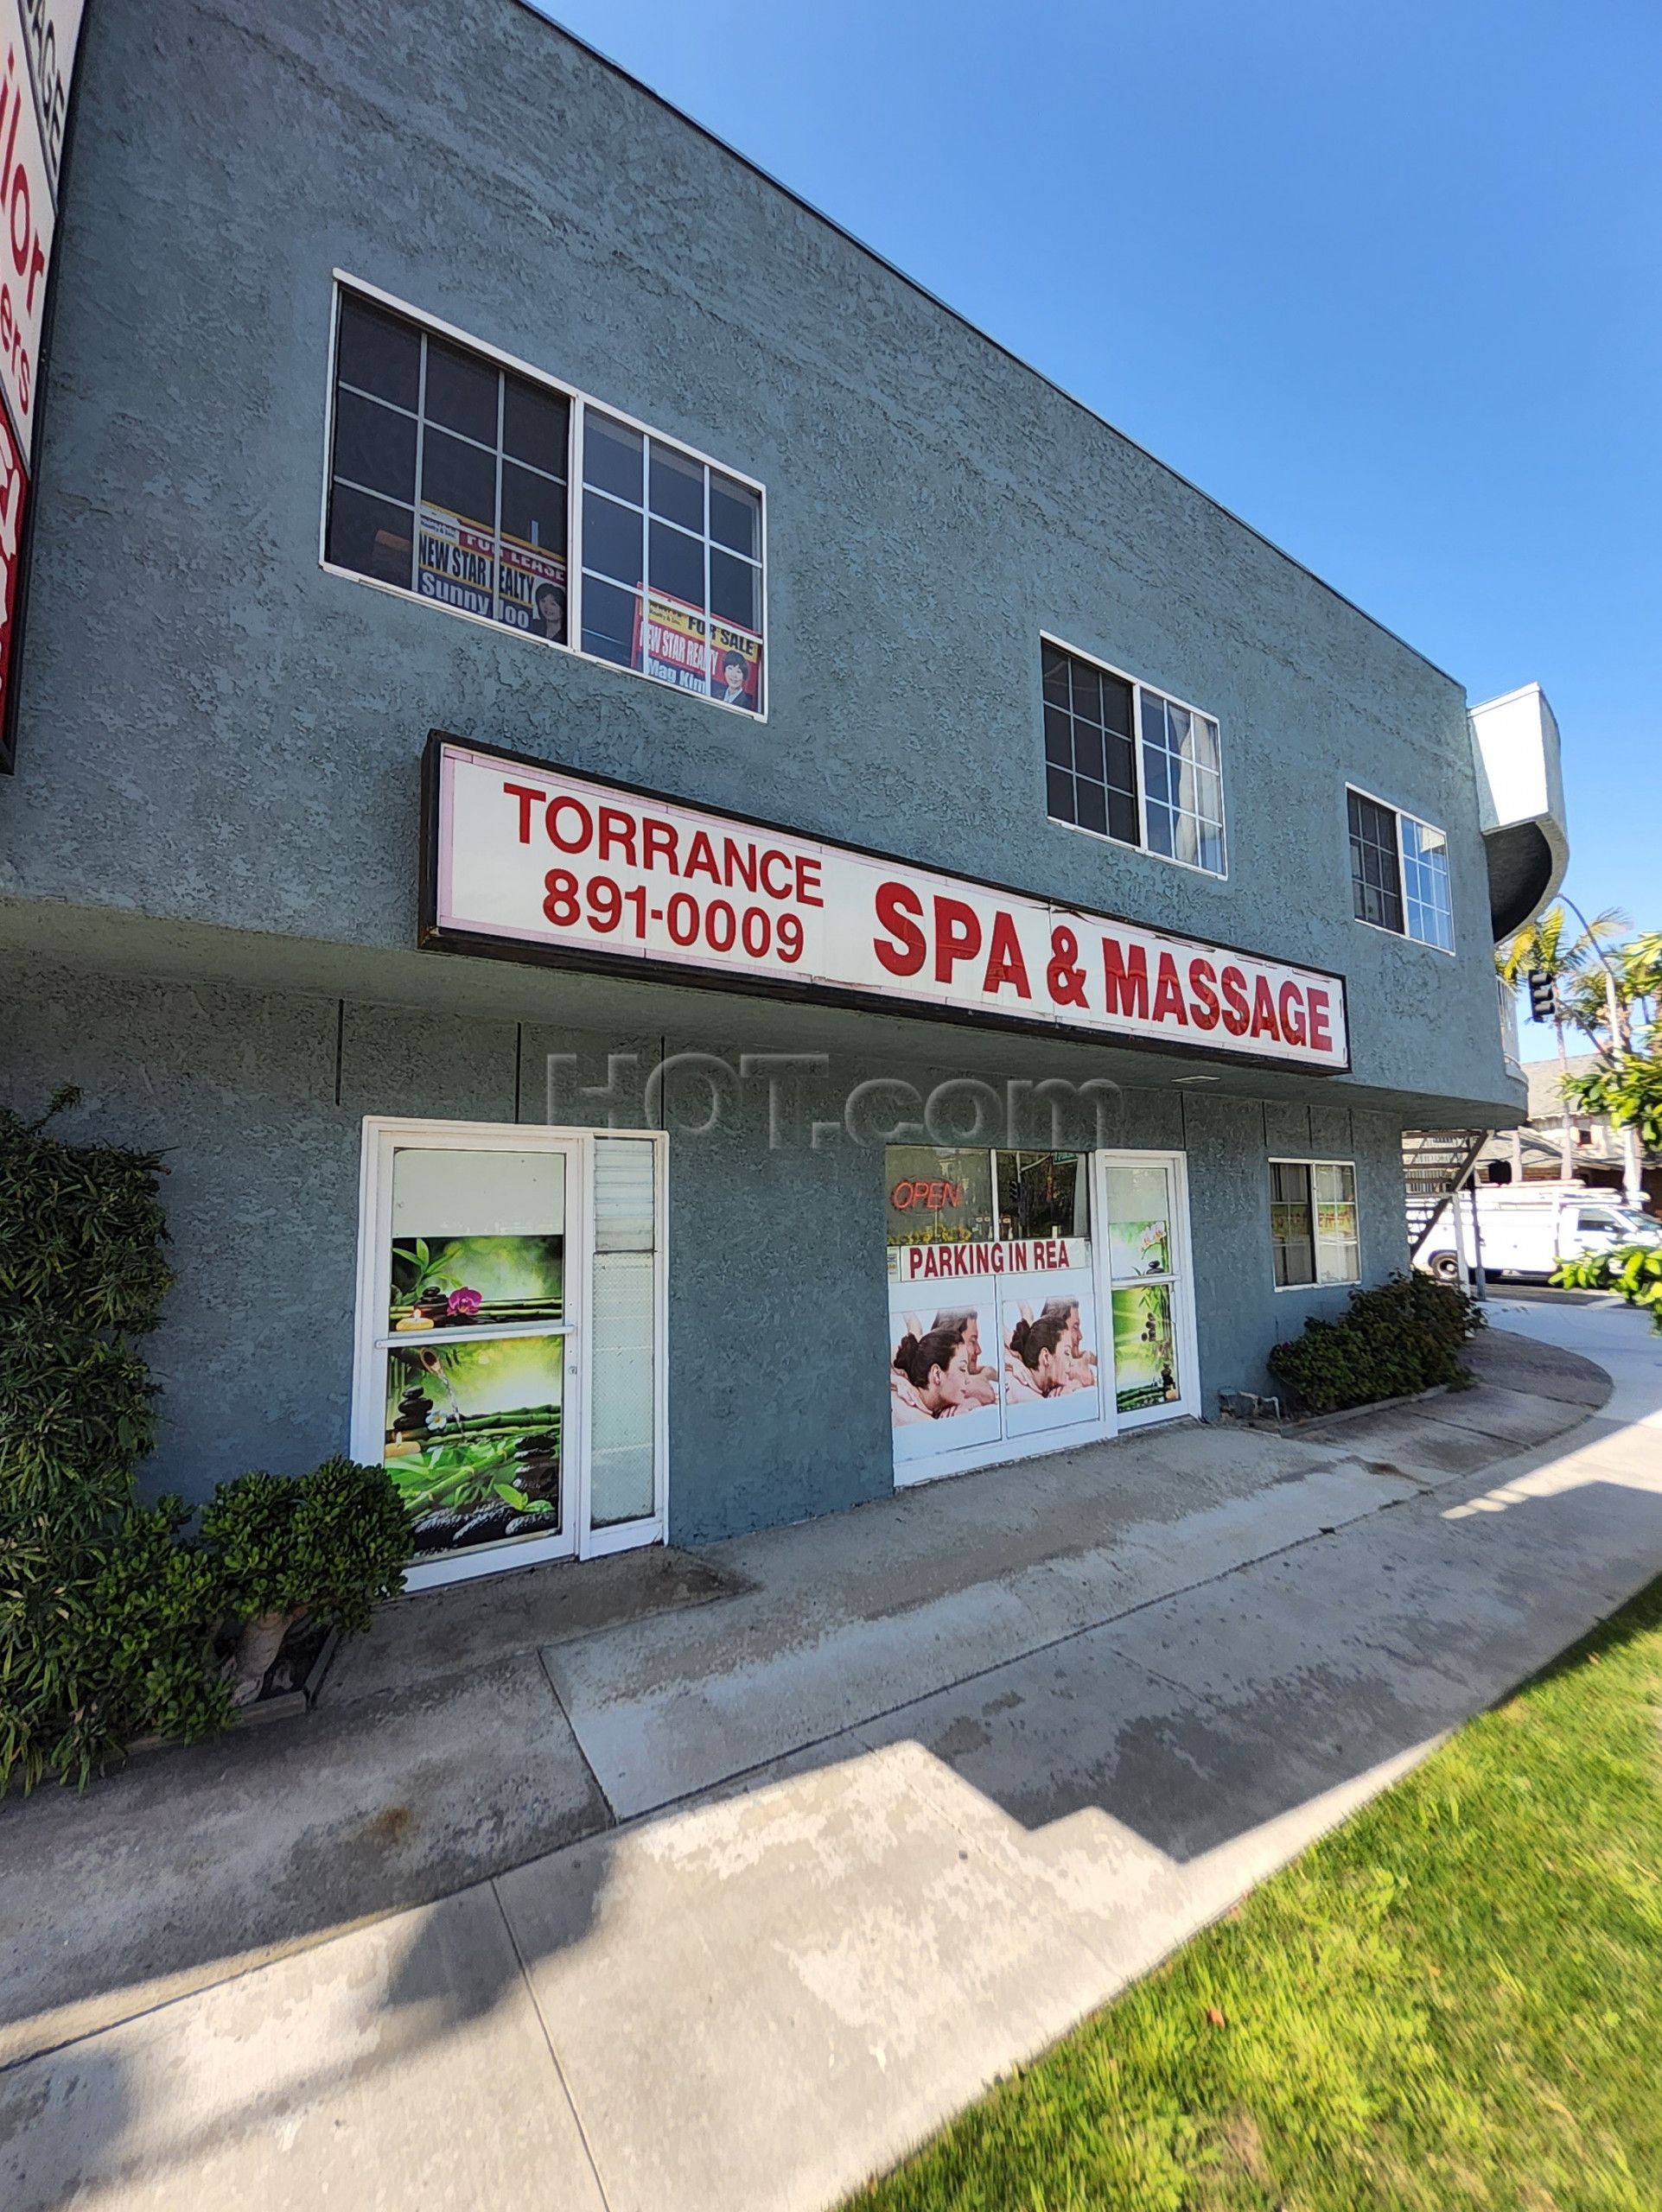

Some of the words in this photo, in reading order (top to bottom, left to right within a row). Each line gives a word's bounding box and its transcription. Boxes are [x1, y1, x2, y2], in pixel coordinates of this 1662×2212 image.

[419, 532, 449, 574] NEW
[452, 546, 487, 588] STAR
[422, 572, 490, 615] Sunny
[662, 630, 685, 663] STAR
[721, 628, 755, 656] SALE
[647, 658, 677, 683] Mag
[503, 782, 825, 907] TORRANCE
[543, 868, 805, 963] 891-0009
[873, 881, 1032, 1000] SPA
[1047, 925, 1090, 1009] &
[1102, 938, 1334, 1052] MASSAGE
[892, 1178, 963, 1211] OPEN
[909, 1241, 1004, 1279] PARKING
[1009, 1239, 1028, 1272] IN
[1034, 1240, 1070, 1270] REA
